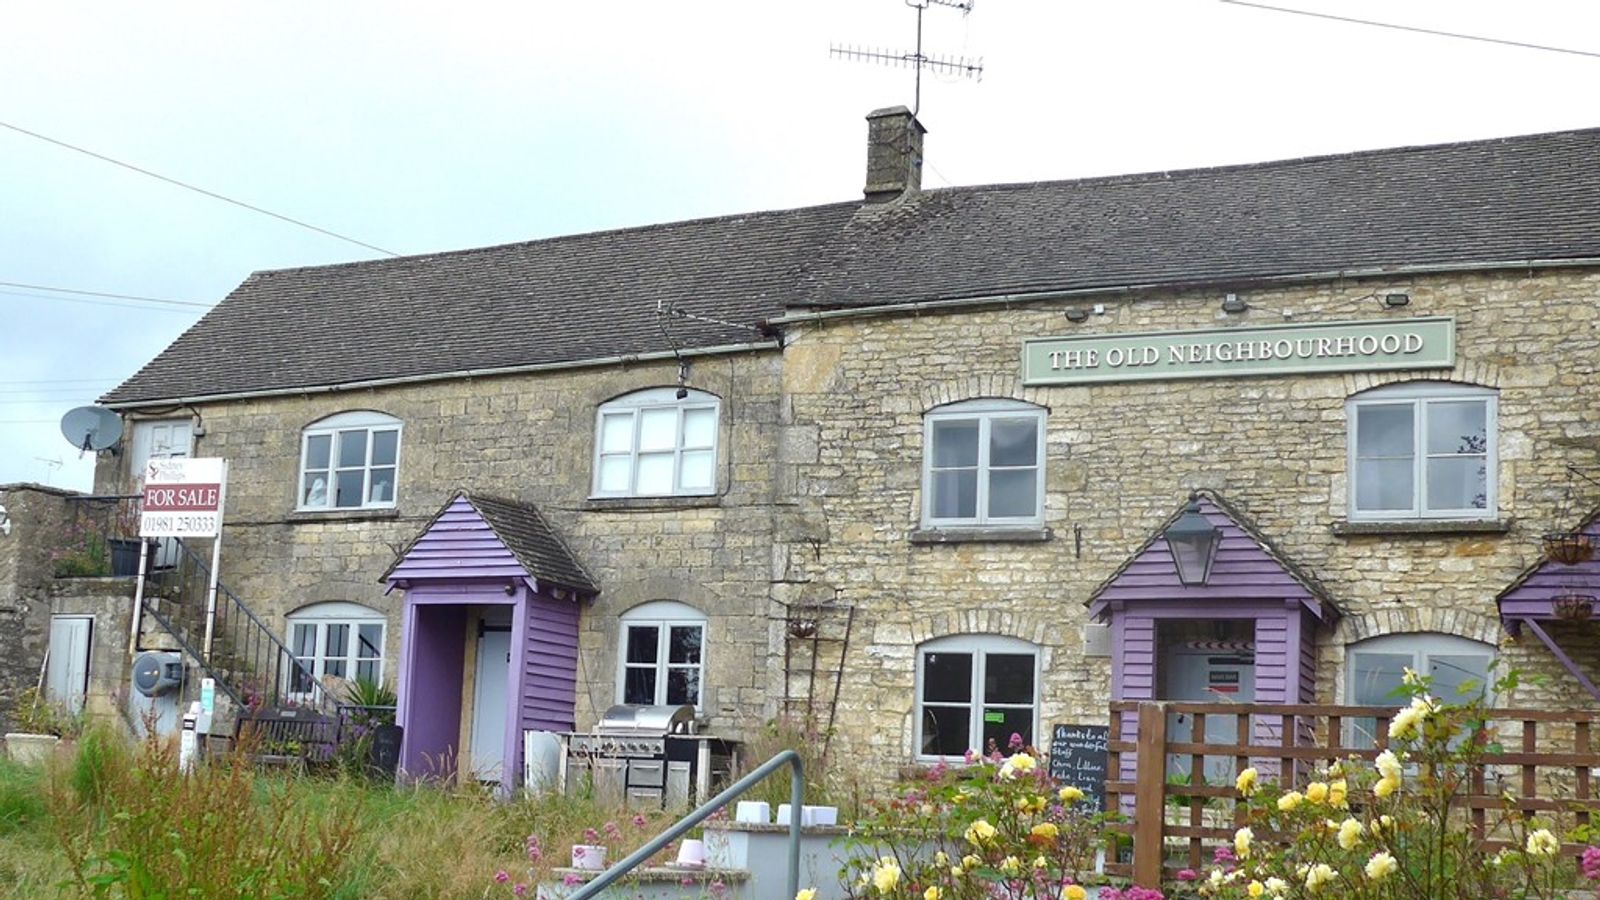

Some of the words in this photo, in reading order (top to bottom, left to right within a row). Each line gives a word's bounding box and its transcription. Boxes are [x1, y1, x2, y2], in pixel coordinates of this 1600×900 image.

[1049, 349, 1099, 369] THE
[1106, 347, 1160, 367] OLD
[1168, 333, 1424, 364] NEIGHBOURHOOD
[146, 489, 175, 506] FOR
[178, 489, 217, 506] SALE
[144, 517, 173, 531] 01981
[177, 517, 215, 532] 250333
[1056, 726, 1085, 740] Thanks
[1069, 740, 1108, 752] wonderful
